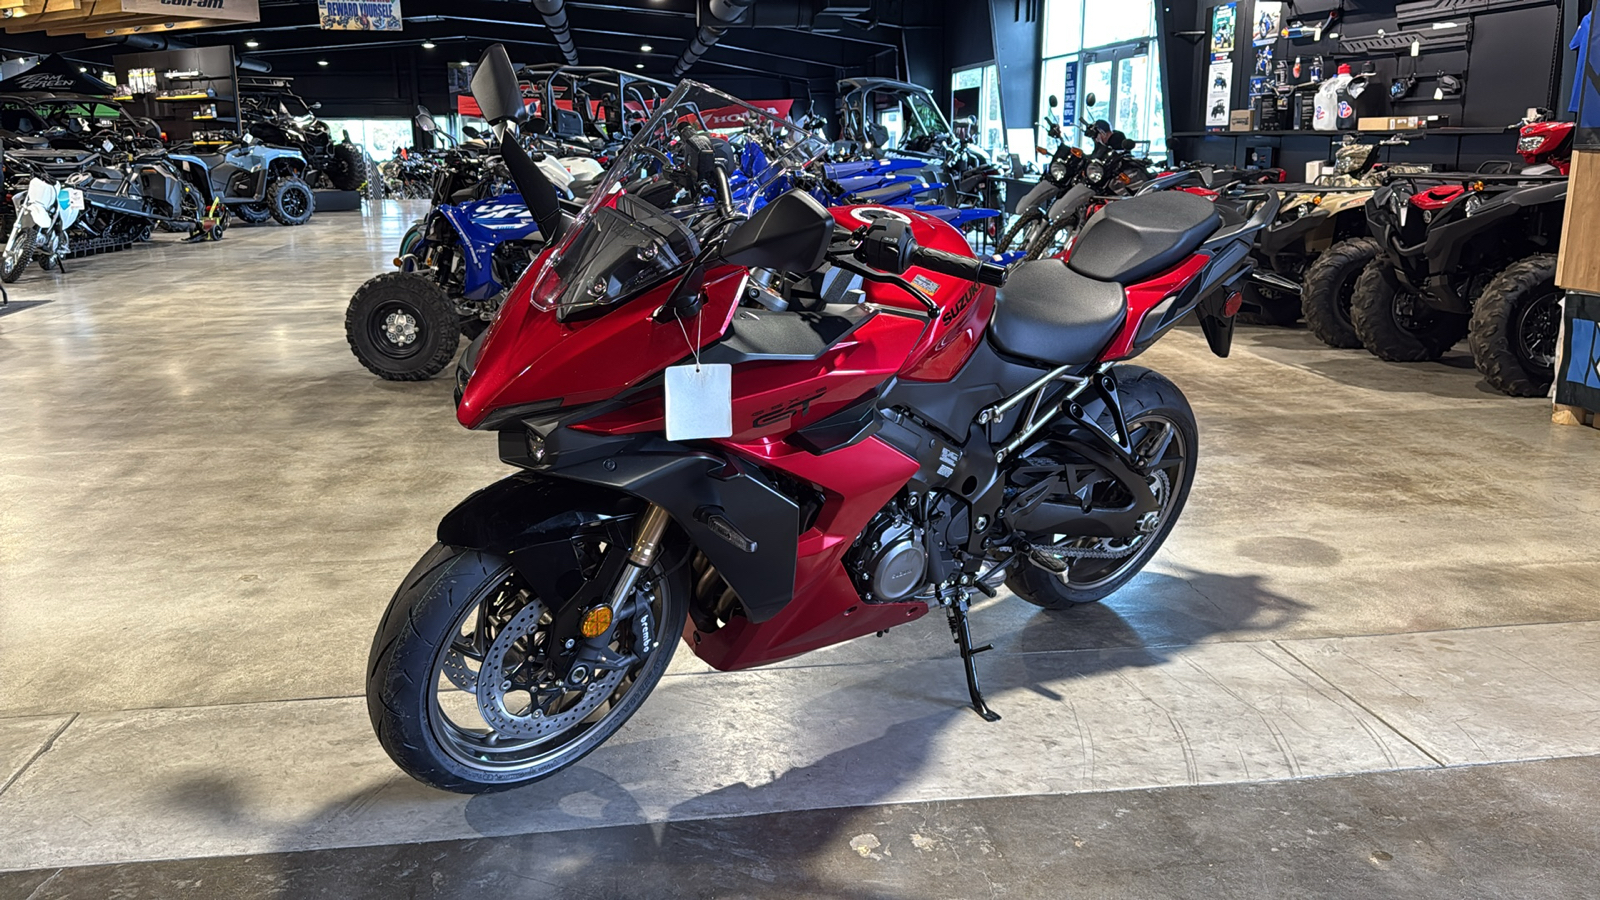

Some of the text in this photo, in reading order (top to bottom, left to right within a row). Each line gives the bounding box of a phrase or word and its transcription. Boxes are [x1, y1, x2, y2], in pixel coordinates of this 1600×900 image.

[327, 2, 358, 17] REWARD
[359, 3, 393, 18] YOURSELF
[16, 73, 63, 83] TEAM
[20, 80, 75, 89] GREEN
[753, 391, 828, 428] GT
[640, 614, 652, 653] brembo
